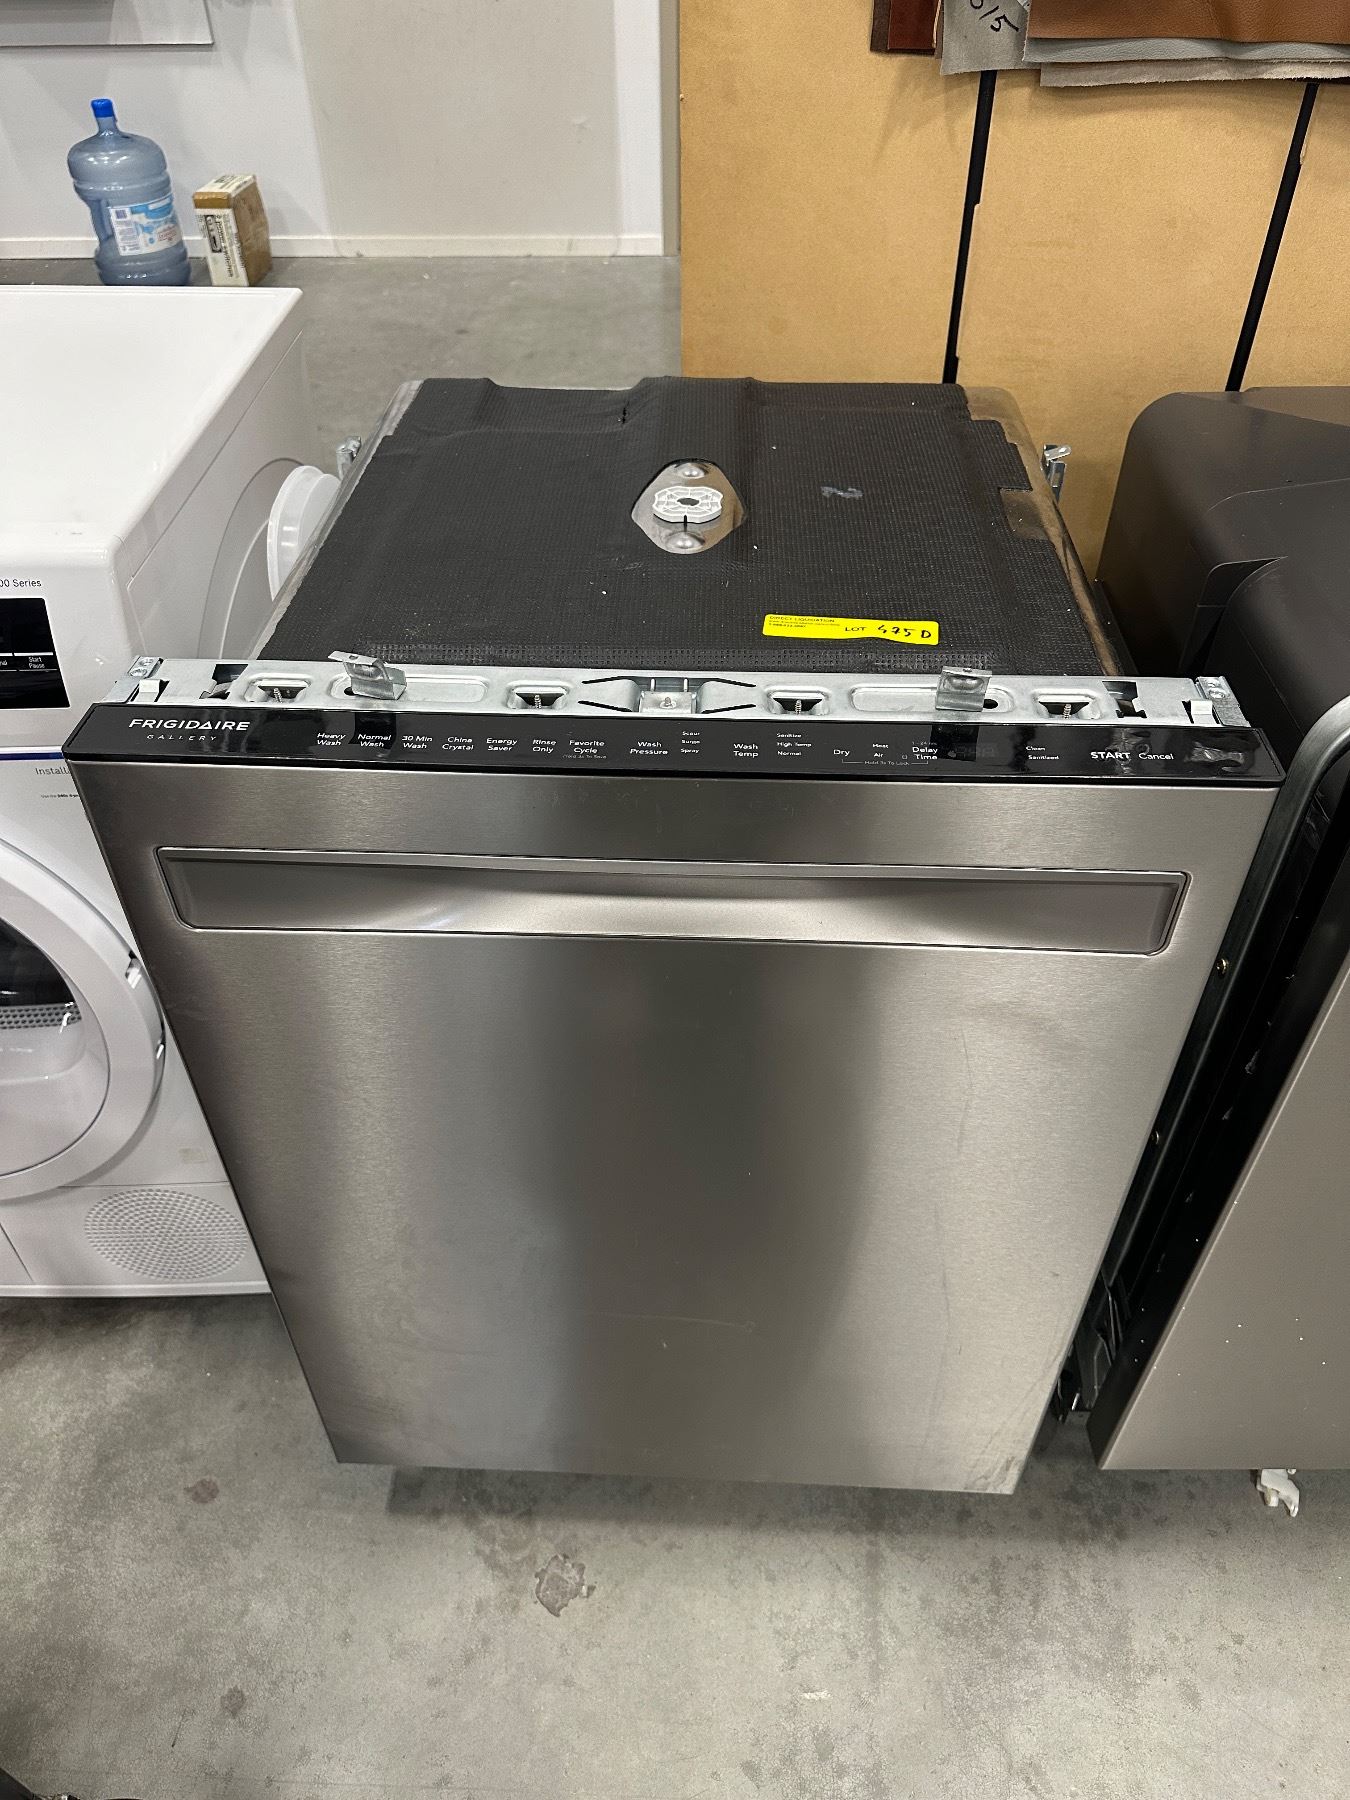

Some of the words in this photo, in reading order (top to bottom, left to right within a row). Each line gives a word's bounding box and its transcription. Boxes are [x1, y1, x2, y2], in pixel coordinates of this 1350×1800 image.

[12, 578, 42, 588] Series
[921, 629, 931, 639] D
[128, 719, 251, 731] FRIGIDAIRE
[316, 732, 346, 740] Heavy
[357, 733, 392, 741] Normal
[486, 737, 518, 746] Energy
[569, 739, 605, 747] Favorite
[442, 743, 474, 751] Crystal
[532, 746, 554, 754] Only
[912, 746, 938, 754] Delay
[733, 750, 759, 758] Temp
[833, 749, 850, 757] Dry
[1090, 751, 1131, 760] START
